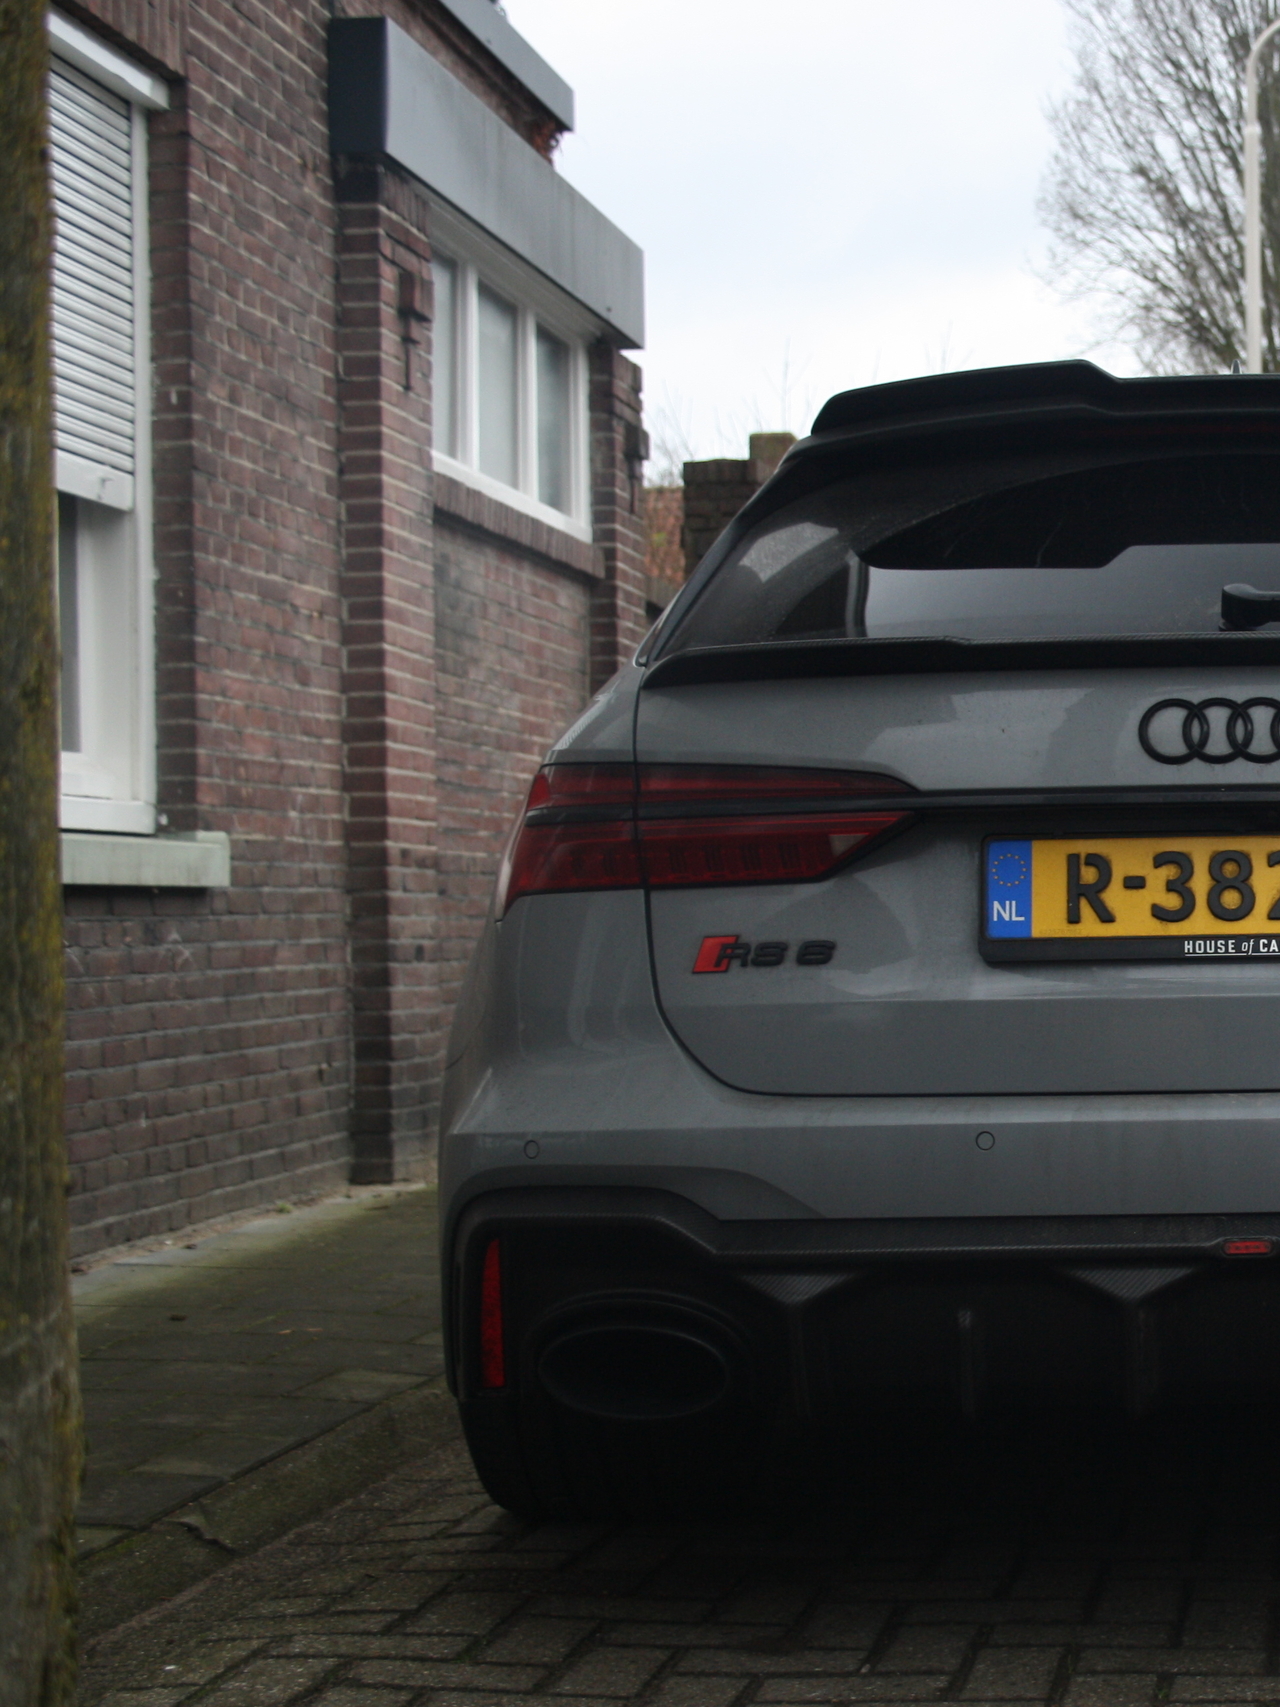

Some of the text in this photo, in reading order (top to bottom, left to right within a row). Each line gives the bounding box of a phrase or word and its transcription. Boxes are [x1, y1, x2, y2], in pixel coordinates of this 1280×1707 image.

[992, 901, 1026, 922] NL
[709, 940, 837, 968] RS 6
[1184, 940, 1236, 953] HOUSE
[1241, 939, 1255, 955] of
